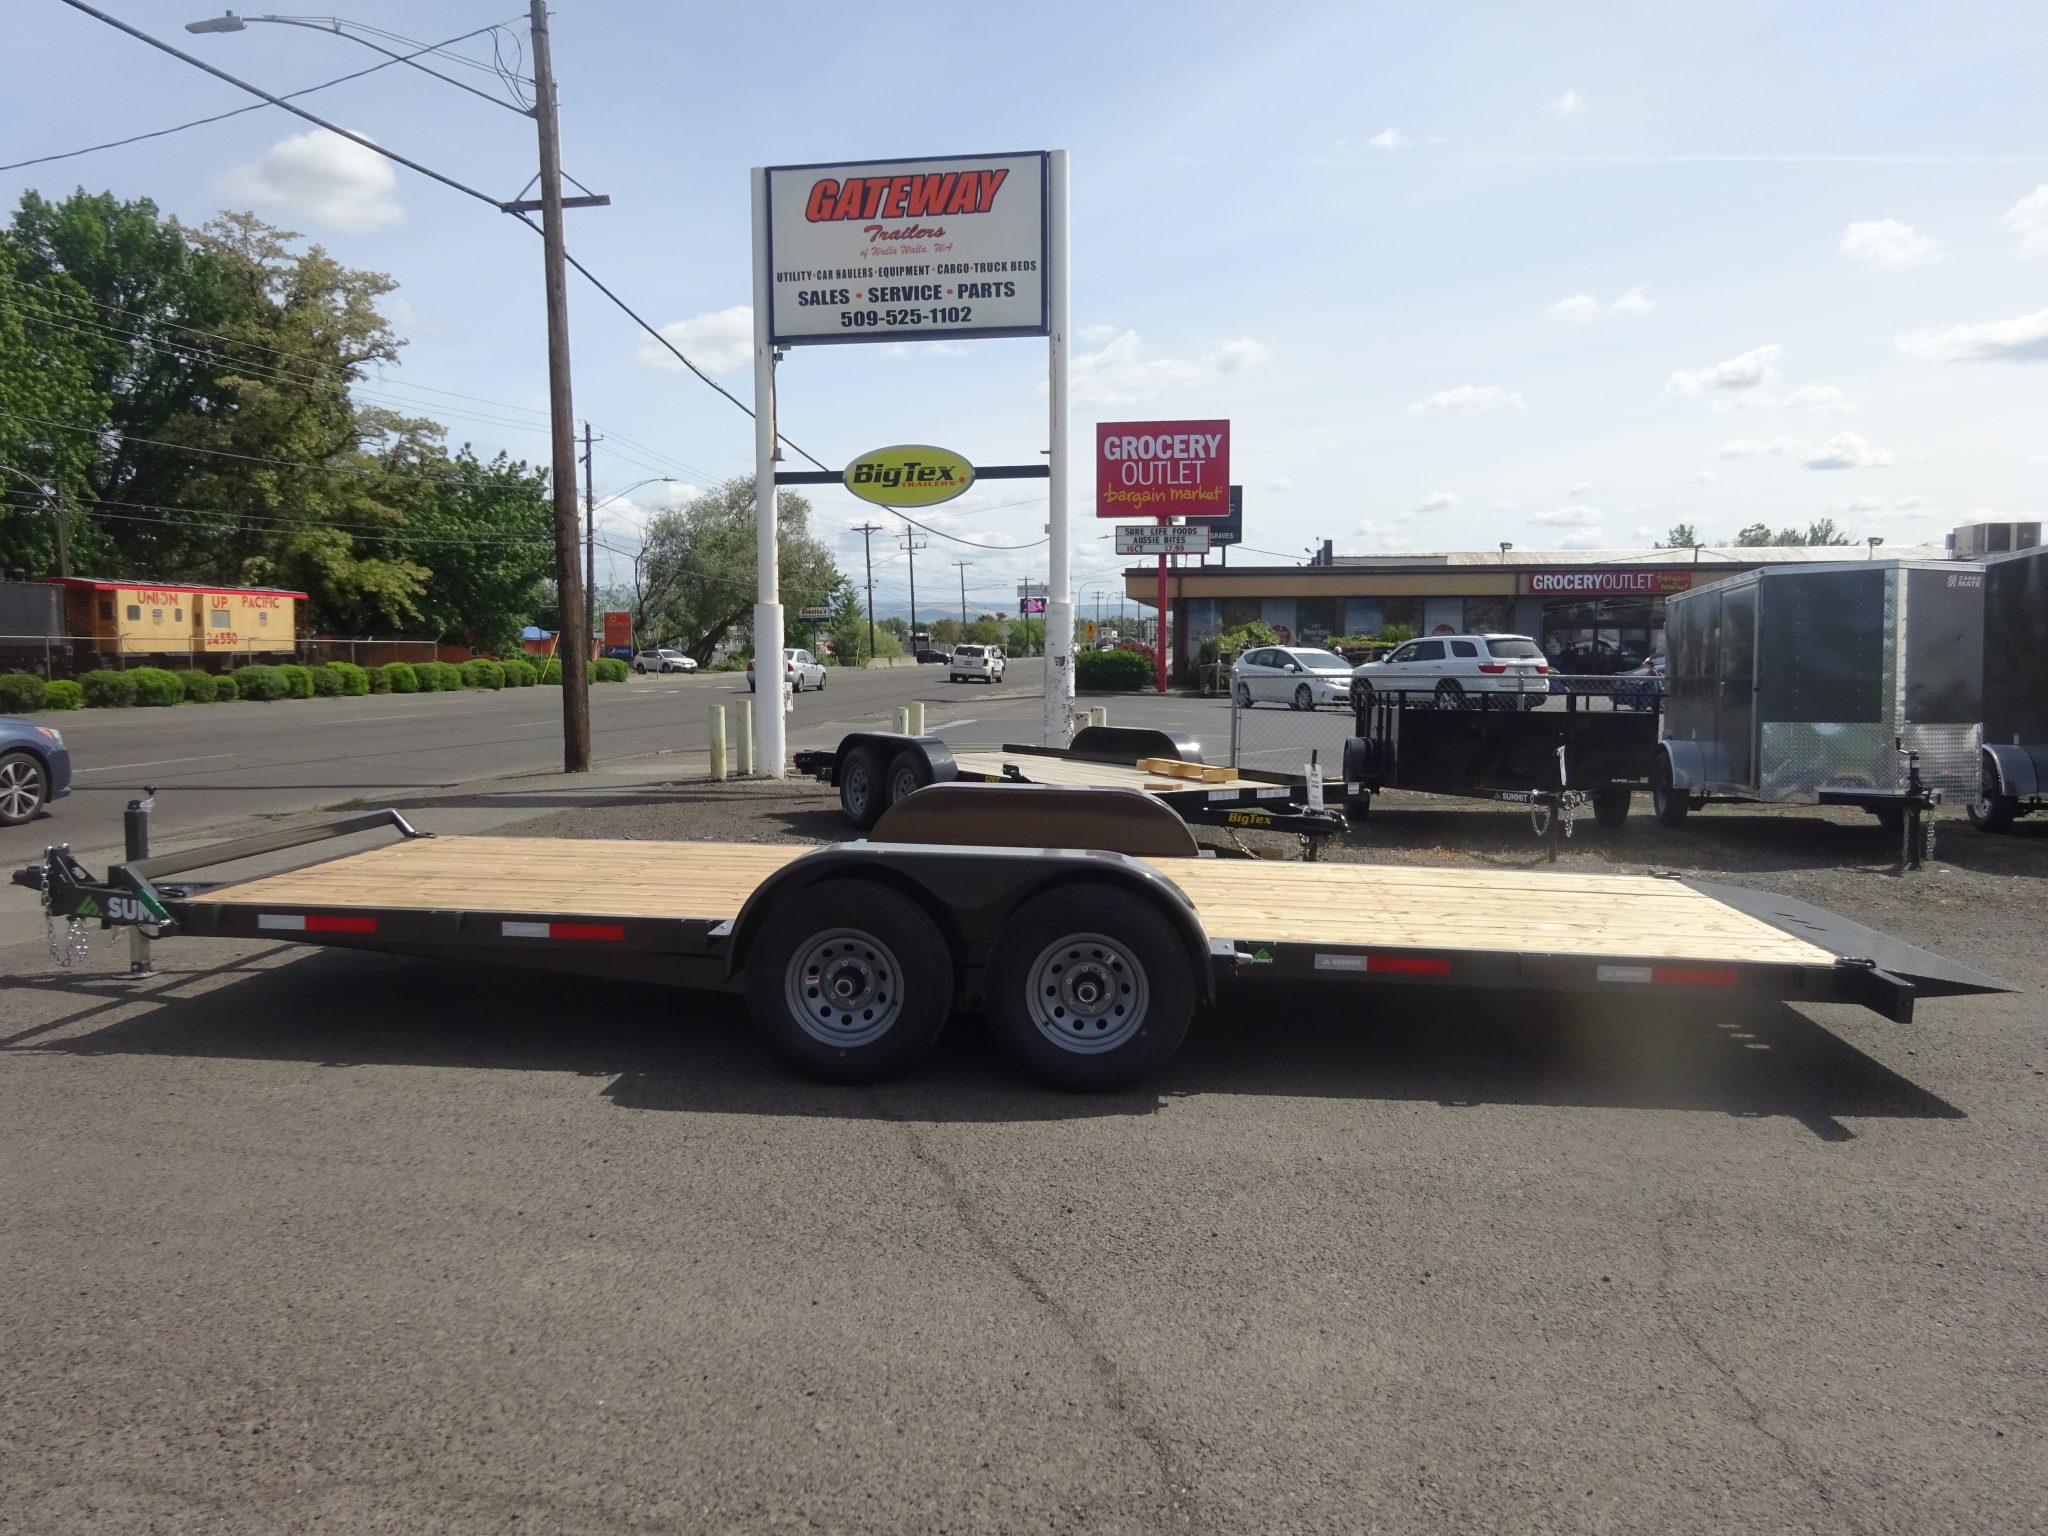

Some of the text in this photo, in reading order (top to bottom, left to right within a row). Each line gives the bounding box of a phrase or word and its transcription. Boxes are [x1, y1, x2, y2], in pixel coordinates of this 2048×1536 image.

[804, 168, 1010, 223] GATEWAY
[863, 223, 946, 243] Trailers
[859, 248, 868, 260] of
[871, 246, 897, 256] Walla
[934, 241, 953, 253] WA
[776, 260, 1037, 283] UTILITY CAR HAULERS EQUIPMENT CARGO TRUCK BEDS
[798, 281, 1016, 307] SALES SERVICE PARTS
[840, 306, 972, 328] 509-525-1102
[1103, 434, 1222, 460] GROCERY
[853, 462, 956, 488] BigTex
[1121, 460, 1206, 485] OUTLET
[902, 481, 956, 489] TRAILERS
[1103, 482, 1222, 510] bargain market
[1124, 527, 1198, 535] SURE LIFE FOODS
[1133, 536, 1186, 544] AUSSIE BITES
[1126, 545, 1144, 553] 16CT
[1957, 580, 1980, 588] MATE
[137, 591, 280, 609] UNION UP PACIFIC
[206, 631, 238, 645] 24550
[1502, 792, 1528, 802] SUMMIT
[1228, 811, 1273, 826] BigTex
